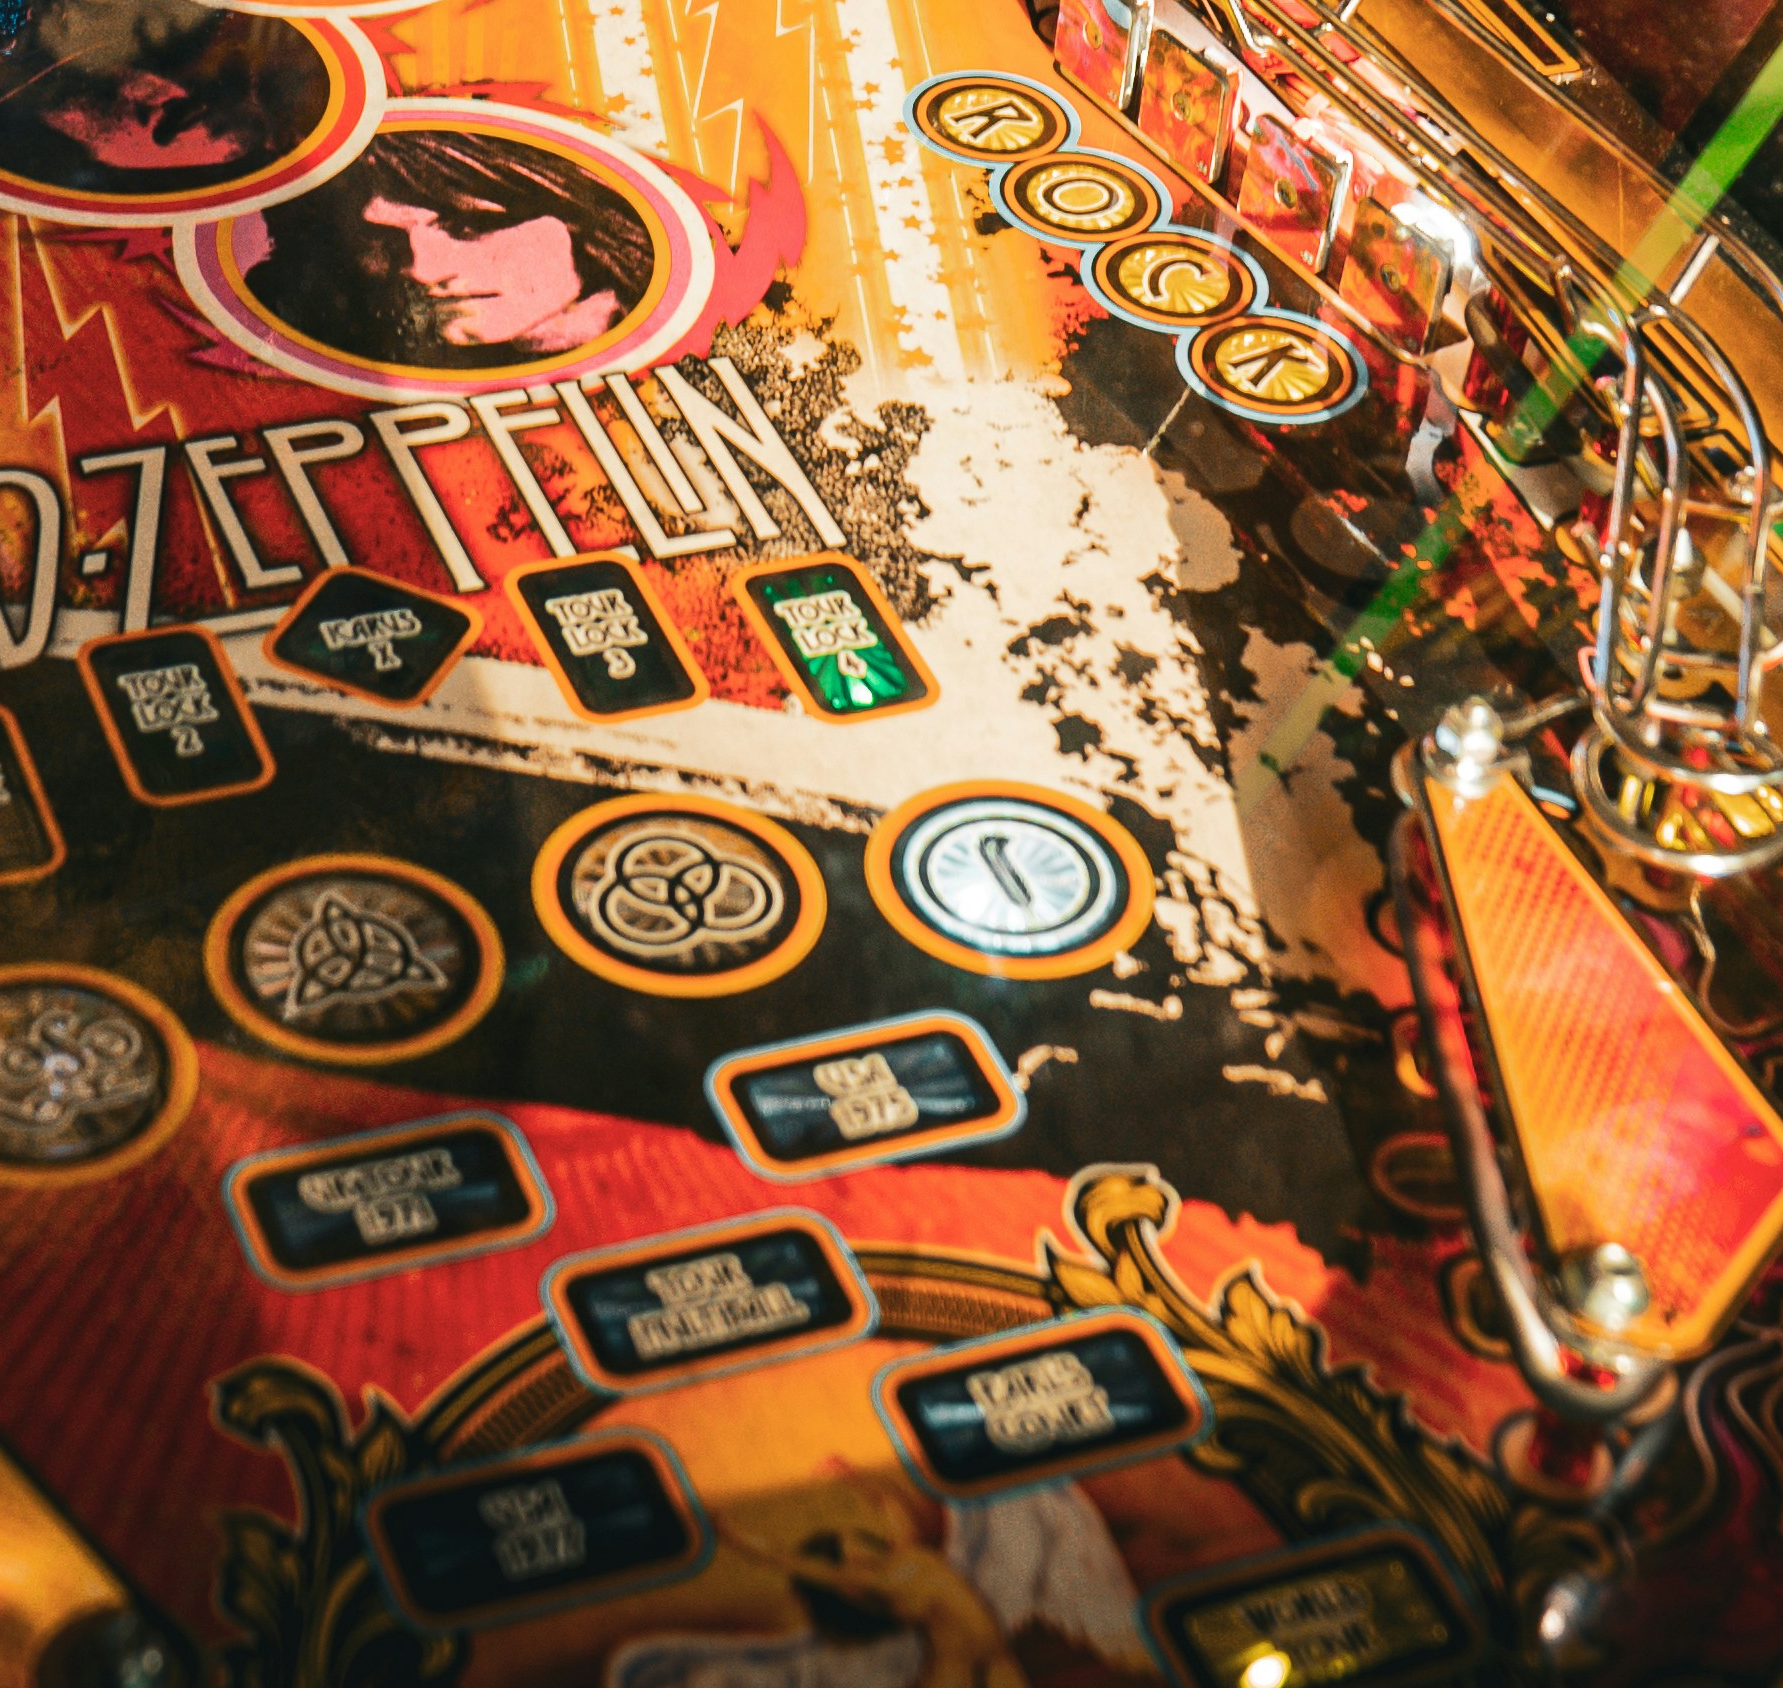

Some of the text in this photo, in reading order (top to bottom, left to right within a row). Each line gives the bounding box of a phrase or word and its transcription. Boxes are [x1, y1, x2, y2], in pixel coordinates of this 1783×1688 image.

[545, 588, 633, 623] TOUR
[773, 589, 863, 626] TOUR
[319, 607, 422, 651] ICARUS
[563, 616, 649, 658] LOCK
[793, 619, 880, 658] LOCK
[118, 663, 208, 702] TOUR
[602, 649, 637, 681] 3
[837, 649, 868, 679] 4
[130, 693, 219, 734] LOCK
[170, 725, 206, 758] 2
